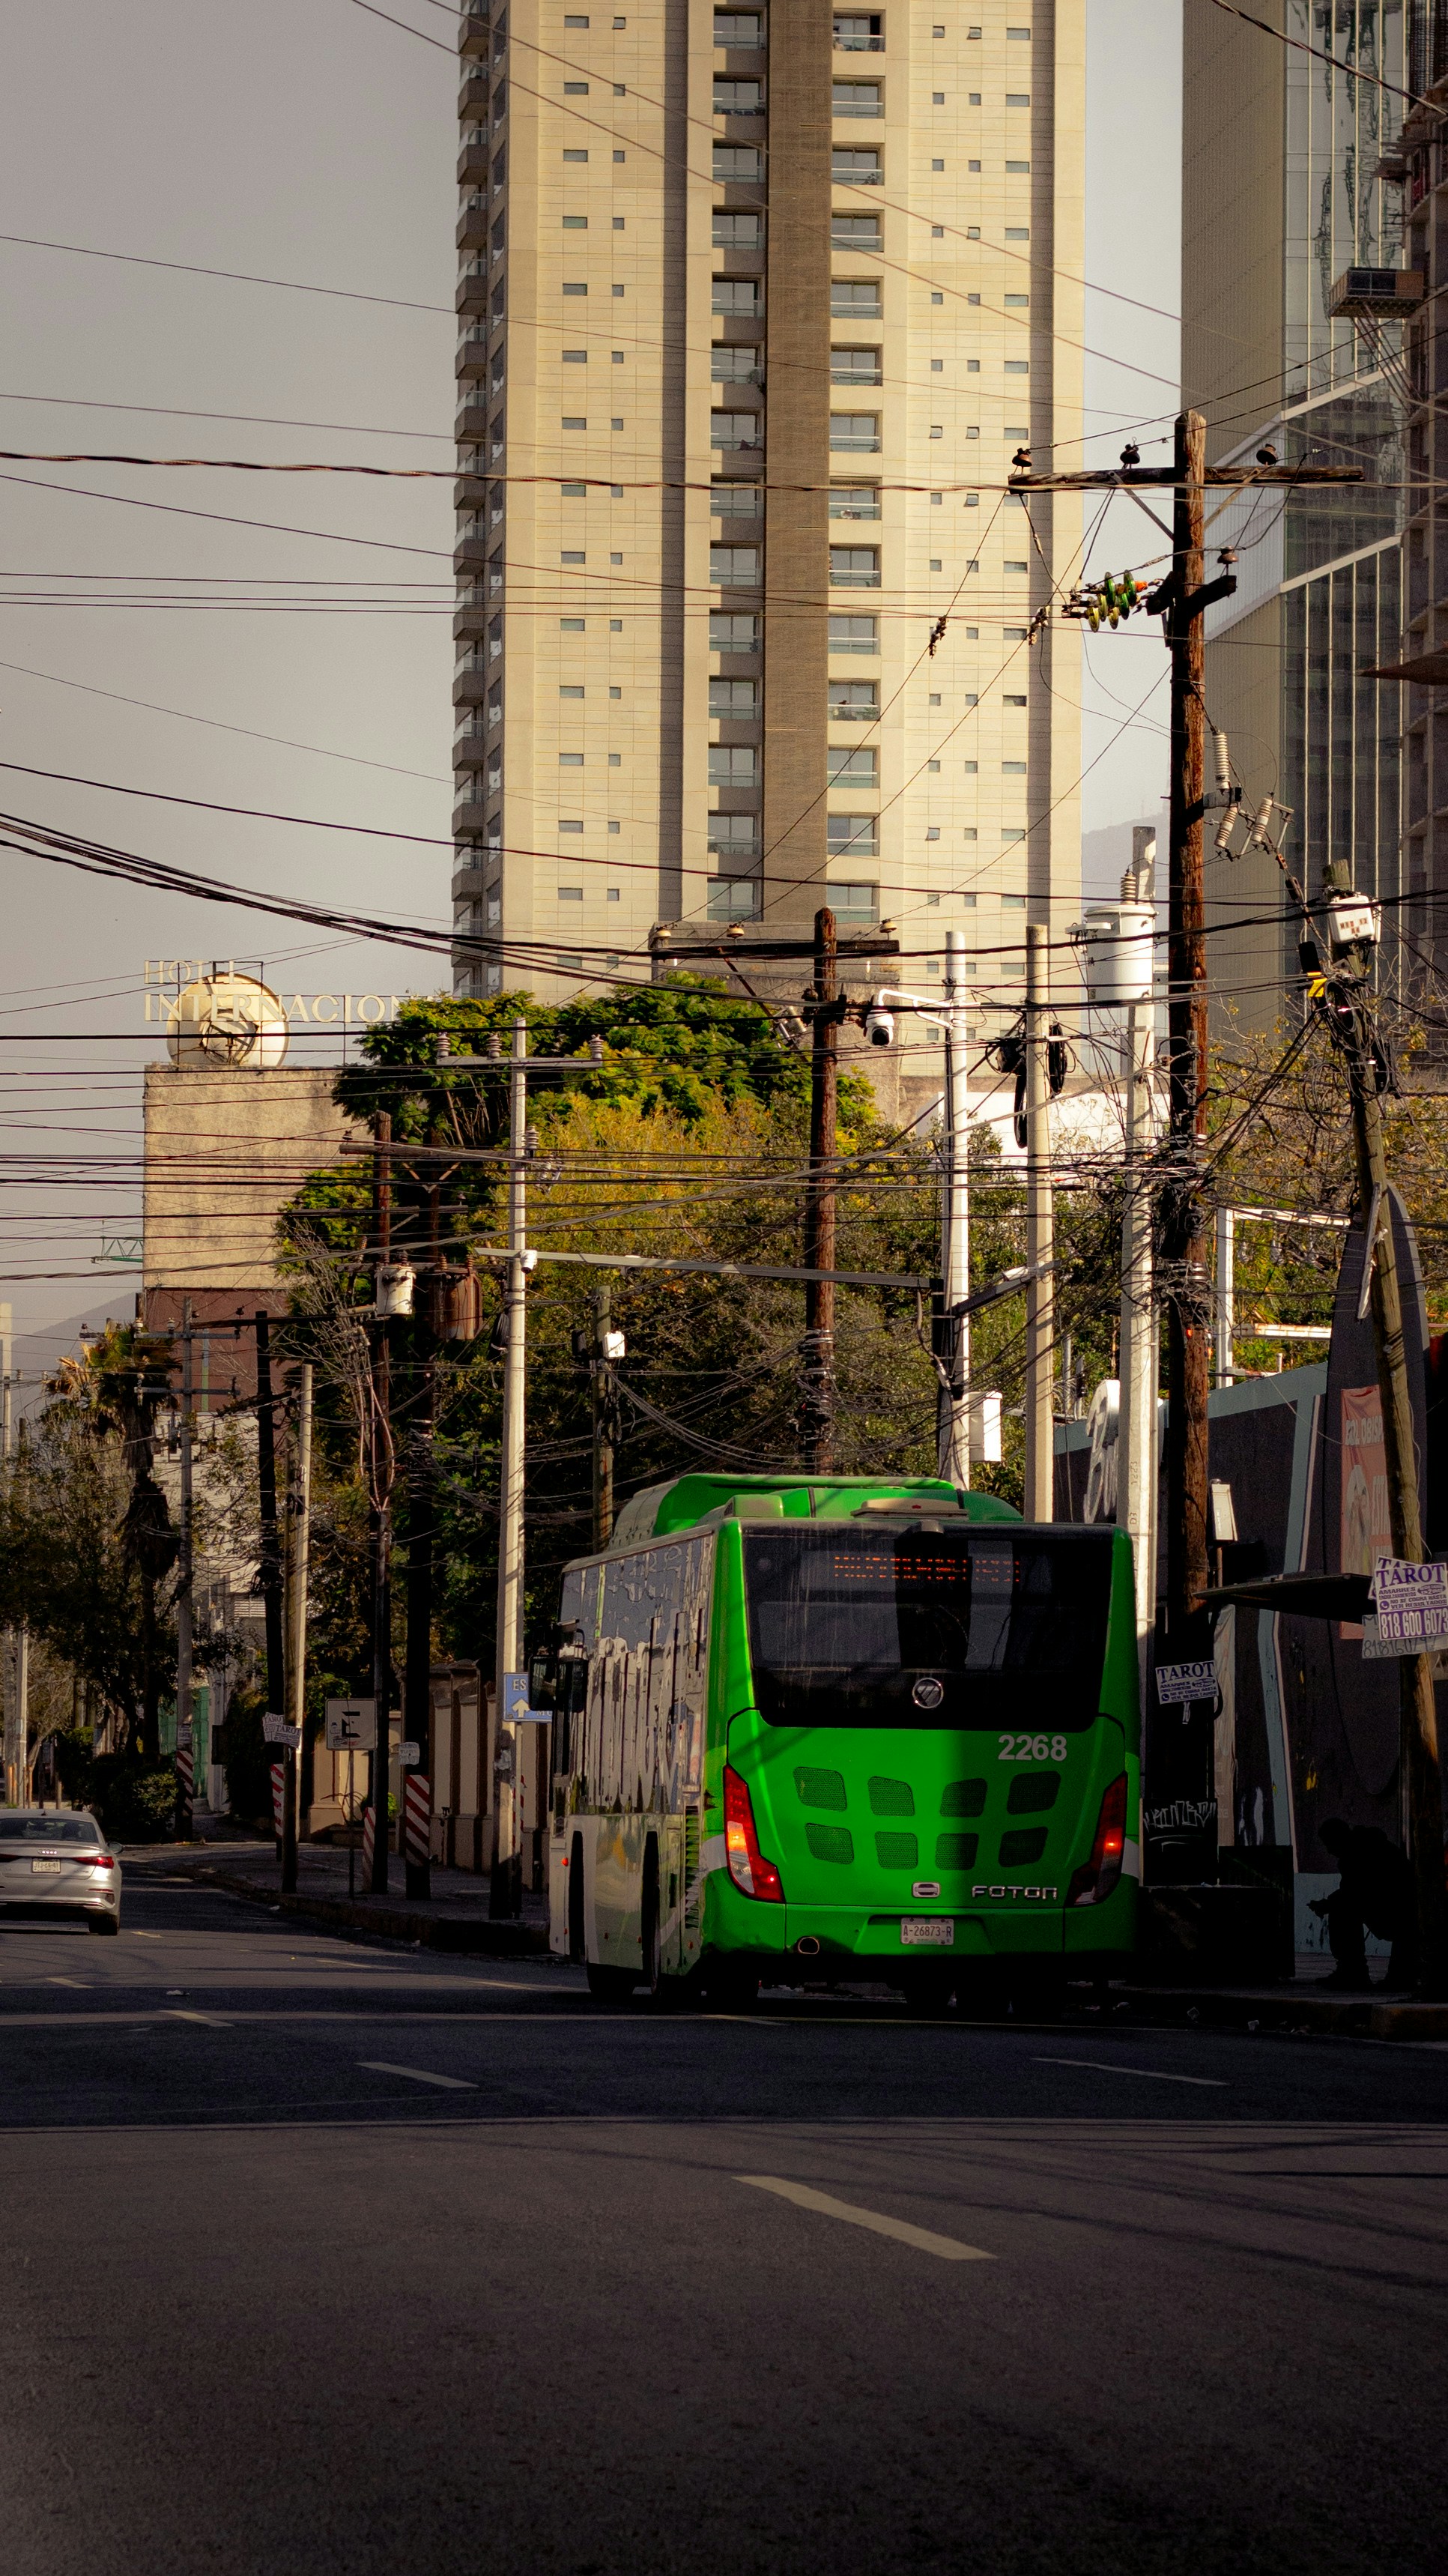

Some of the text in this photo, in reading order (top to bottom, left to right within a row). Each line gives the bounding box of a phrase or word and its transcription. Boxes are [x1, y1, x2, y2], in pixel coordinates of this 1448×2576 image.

[144, 960, 237, 984] HOTEL
[144, 994, 449, 1023] INTERNACION
[1376, 1564, 1445, 1588] TAROT
[1378, 1586, 1416, 1595] AMARRES
[1381, 1612, 1402, 1639] 818
[1402, 1609, 1423, 1636] 600
[1157, 1662, 1215, 1684] TAROT
[276, 1724, 300, 1735] TAROT
[998, 1734, 1067, 1762] 2268
[972, 1884, 1058, 1900] FOTON
[903, 1925, 952, 1937] A-26873-R
